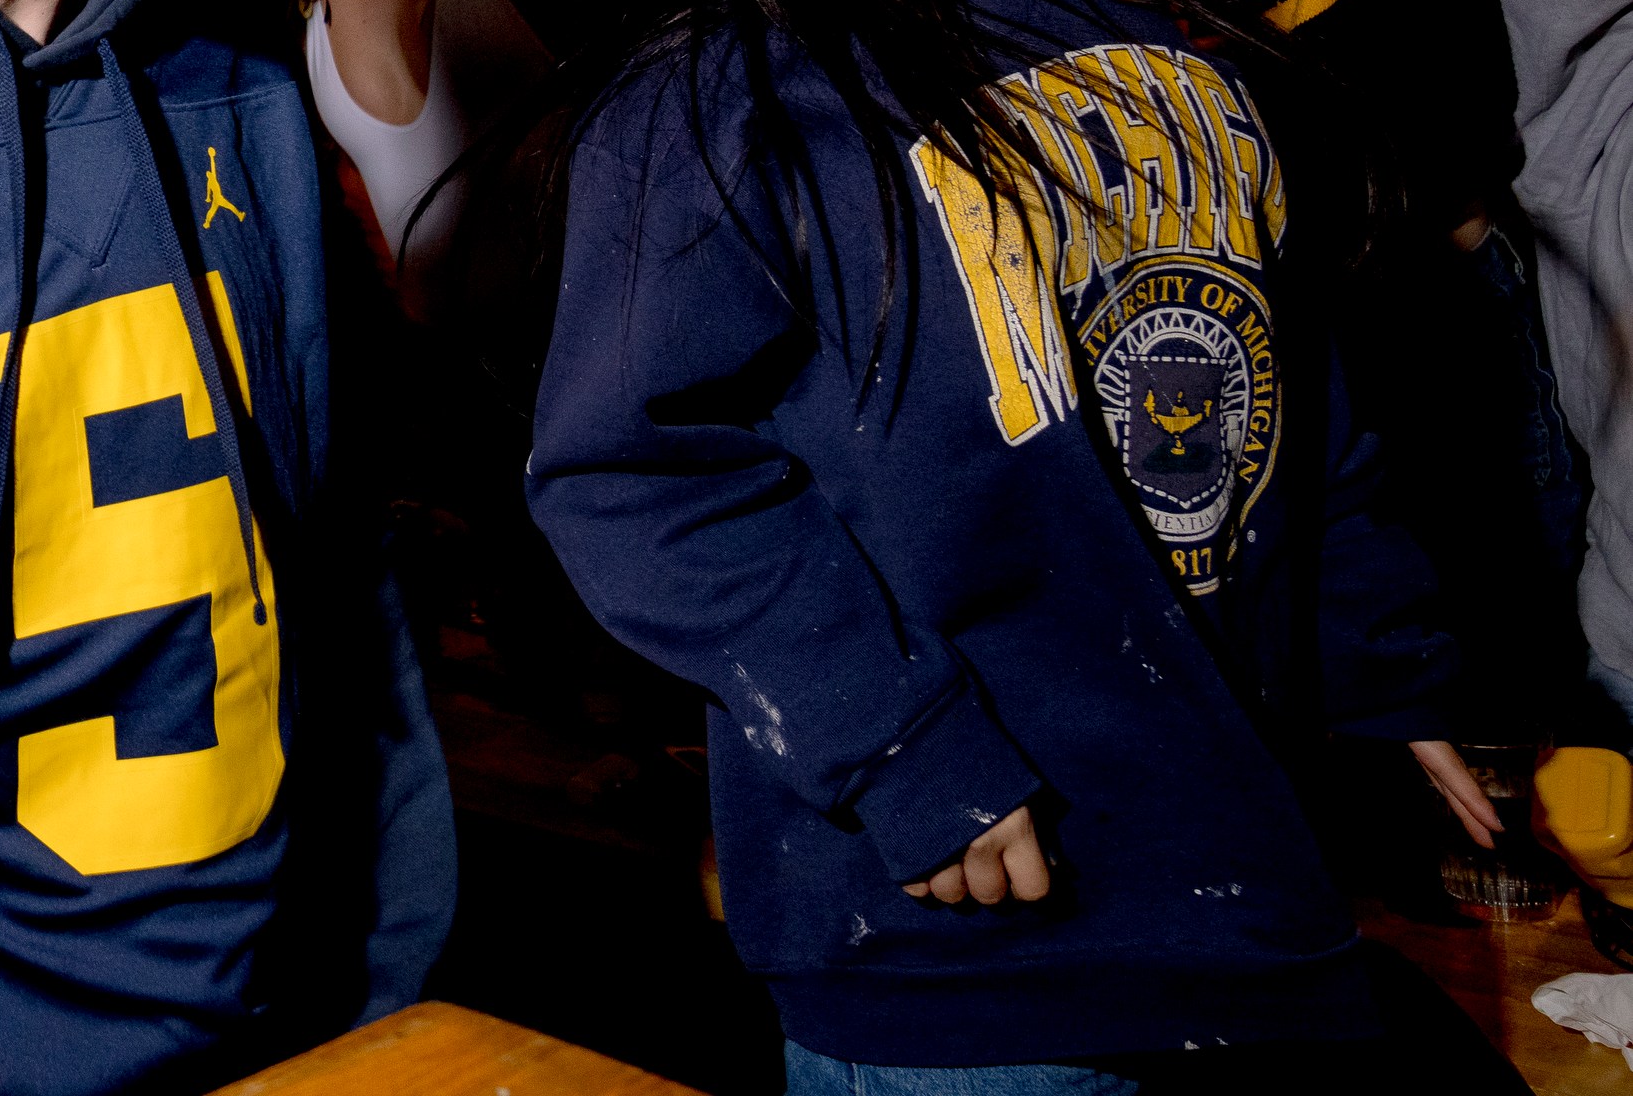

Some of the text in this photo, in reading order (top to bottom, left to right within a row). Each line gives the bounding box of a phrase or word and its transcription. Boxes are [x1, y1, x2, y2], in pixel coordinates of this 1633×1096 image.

[1082, 275, 1273, 484] IVERSITY OF MICHIGAN
